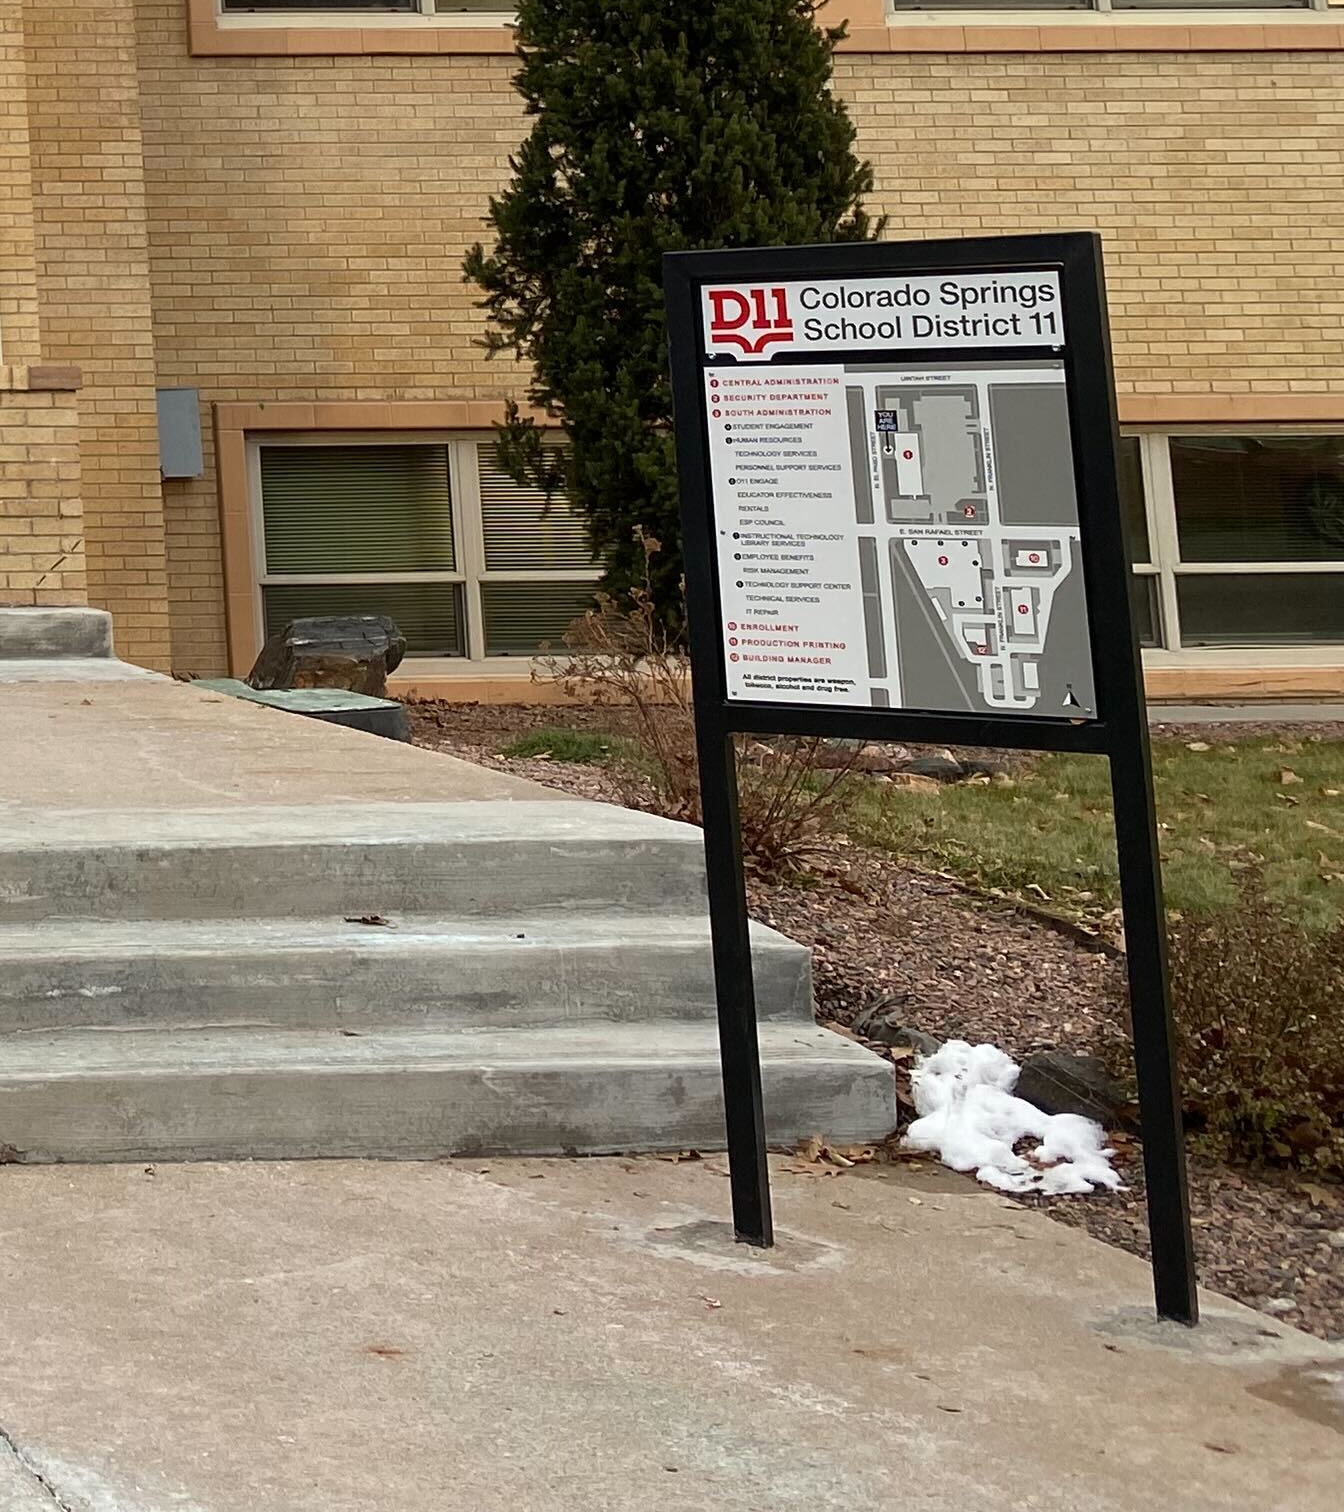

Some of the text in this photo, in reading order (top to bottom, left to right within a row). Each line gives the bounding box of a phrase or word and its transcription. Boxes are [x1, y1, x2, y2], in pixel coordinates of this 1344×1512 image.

[800, 281, 1055, 311] Colorado Springs
[708, 288, 793, 330] D11
[804, 312, 1057, 341] School District 11
[764, 378, 840, 386] ADMINISTRATION
[724, 394, 766, 402] SECURITY
[770, 393, 829, 401] DEPARTMENT
[983, 427, 991, 451] STREET
[740, 624, 799, 632] ENROLLMENT
[742, 639, 800, 648] PRODUCTION
[803, 642, 846, 650] PRINTING
[787, 656, 832, 664] MANAGER
[777, 676, 812, 684] properties
[817, 685, 832, 693] drug
